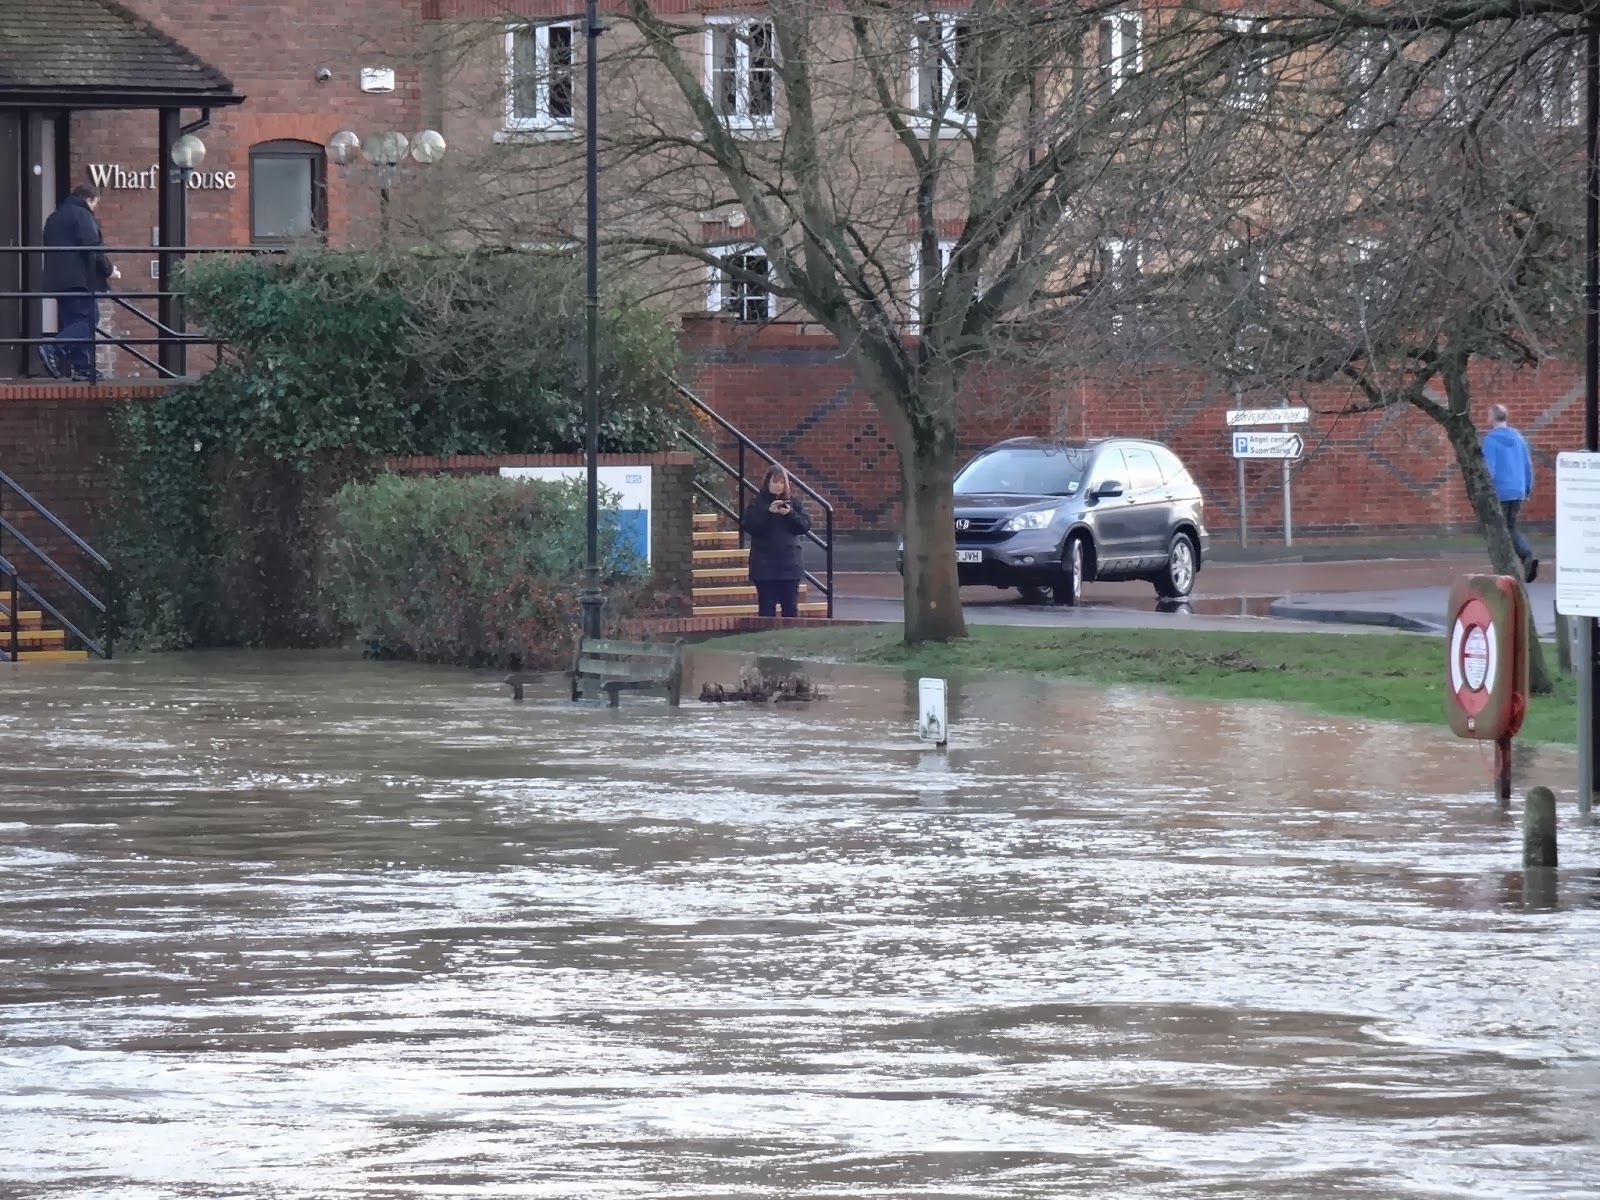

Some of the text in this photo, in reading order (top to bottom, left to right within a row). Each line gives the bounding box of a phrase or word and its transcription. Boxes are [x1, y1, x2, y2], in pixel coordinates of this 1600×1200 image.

[88, 163, 236, 189] Wharf ouse
[1237, 438, 1247, 452] P
[1250, 436, 1268, 445] Angel
[962, 551, 978, 561] JVH
